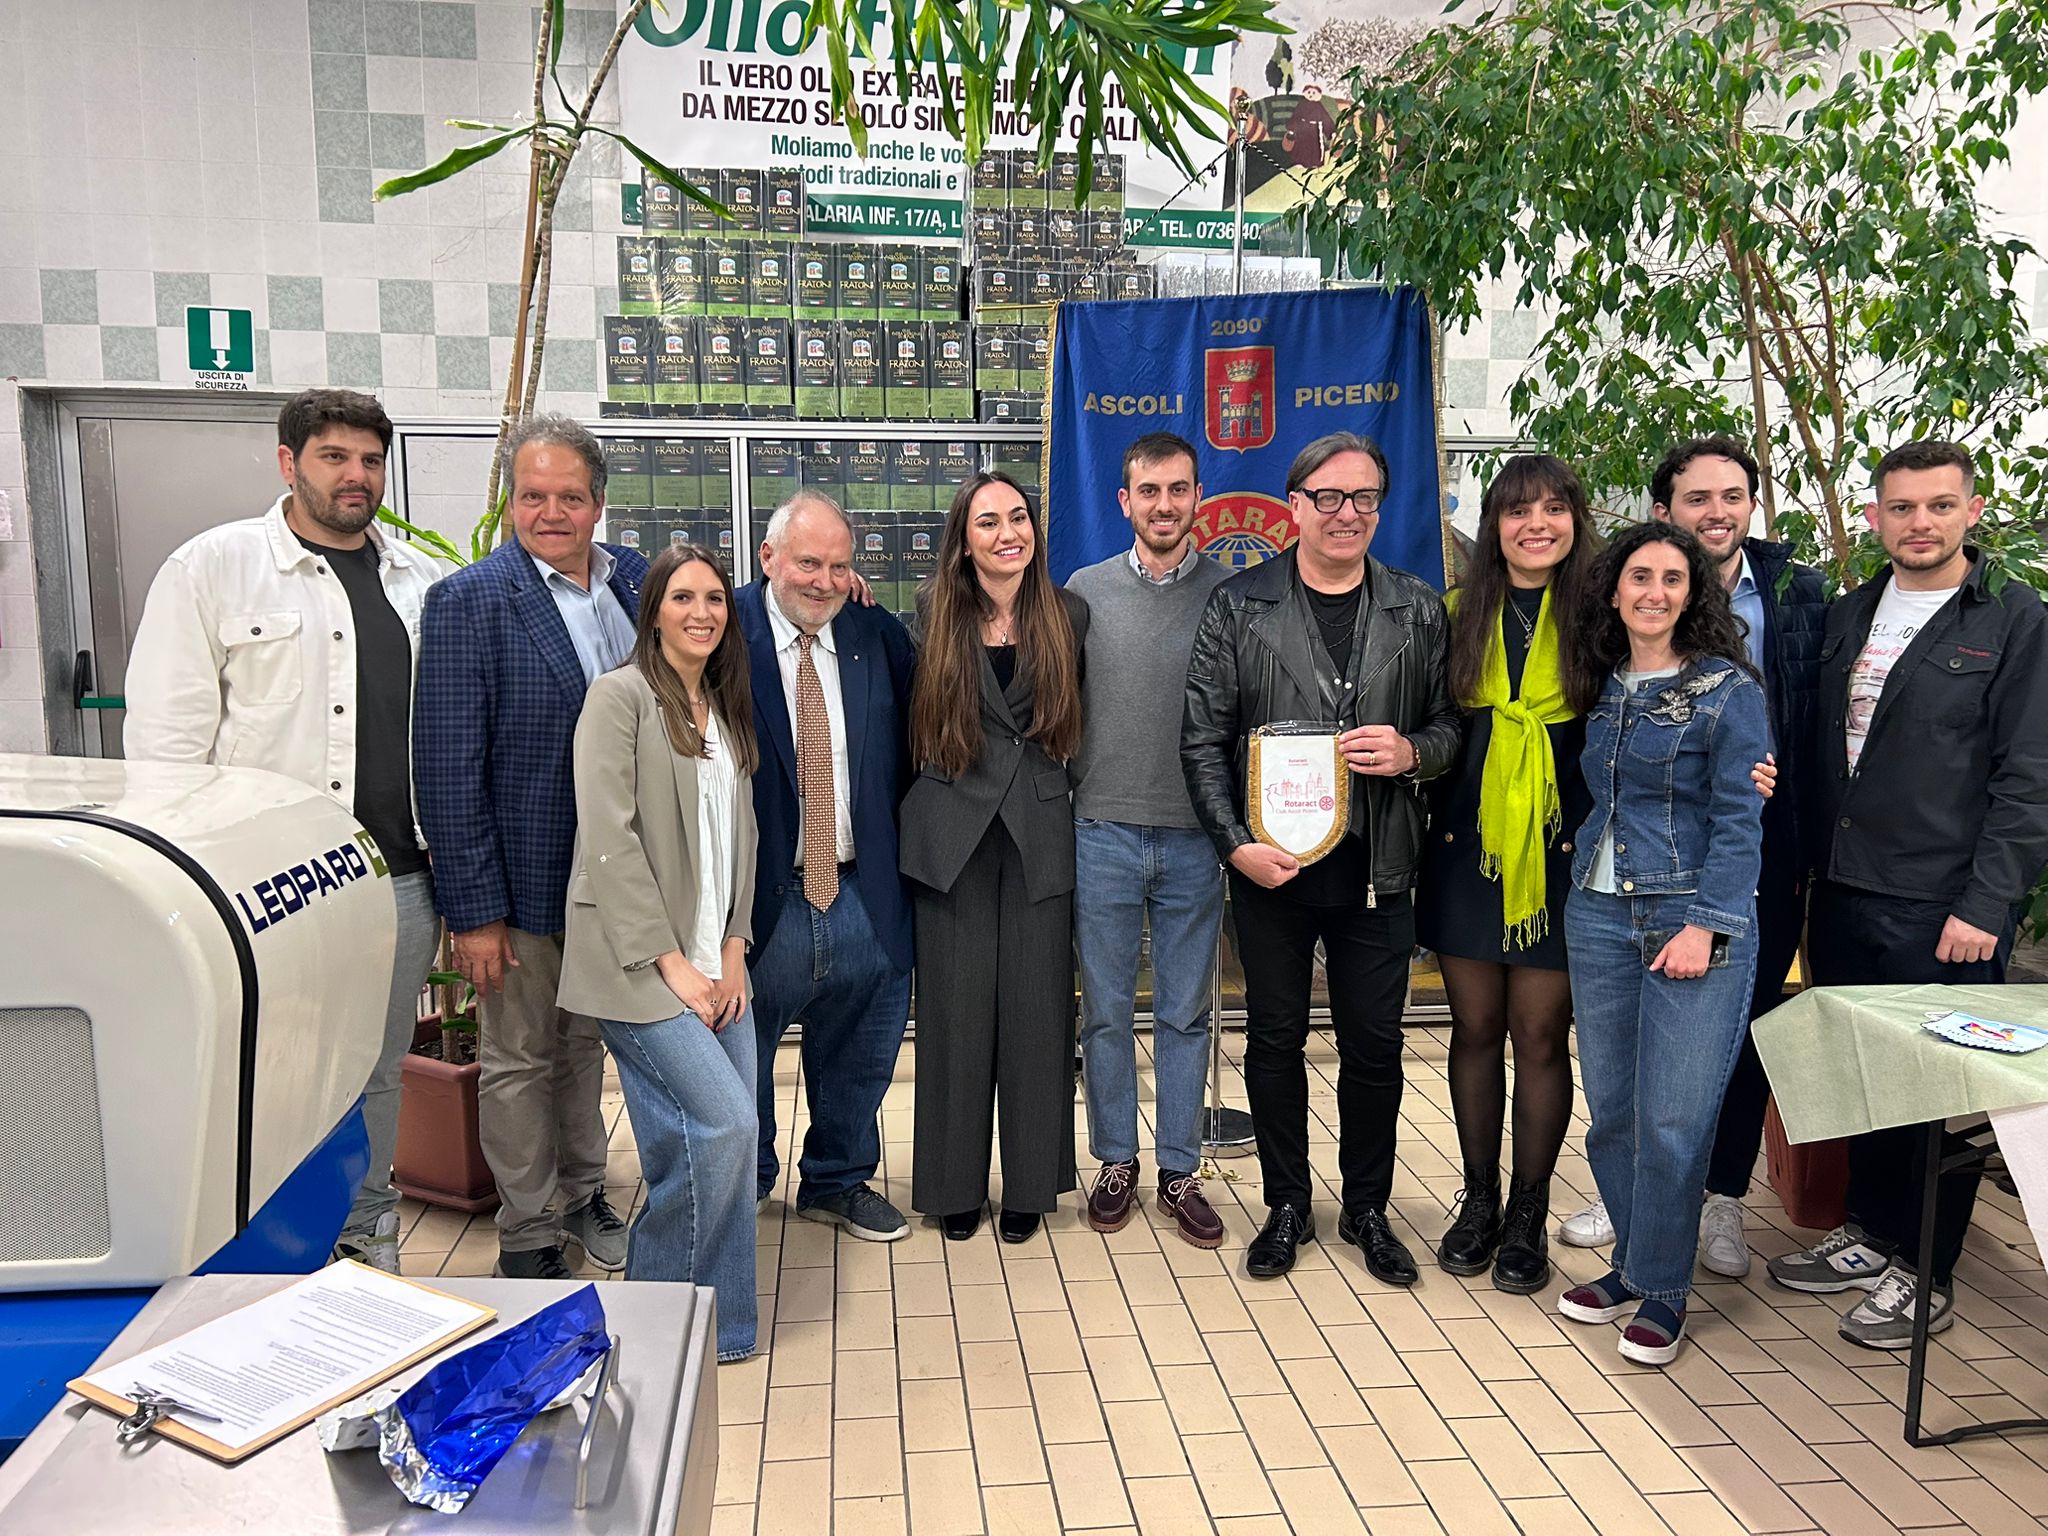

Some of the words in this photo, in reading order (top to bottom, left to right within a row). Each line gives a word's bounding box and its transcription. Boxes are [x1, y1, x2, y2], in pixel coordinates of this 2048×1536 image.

[700, 59, 721, 87] IL
[727, 63, 793, 91] VERO
[682, 92, 717, 120] DA
[724, 95, 807, 125] MEZZO
[771, 134, 852, 159] Moliamo
[865, 140, 914, 161] nche
[920, 142, 935, 162] le
[839, 166, 941, 190] tradizionali
[946, 174, 957, 190] e
[806, 205, 864, 224] ALARIA
[869, 206, 899, 226] INF.
[904, 208, 946, 231] 17/A,
[1159, 219, 1192, 239] TEL.
[194, 381, 248, 391] SICUREZZA
[198, 371, 232, 380] USCITA
[234, 372, 244, 381] DI
[1084, 392, 1184, 416] ASCOLI
[1294, 382, 1400, 408] PICENO
[1284, 800, 1317, 808] Rotaract
[235, 842, 368, 935] LEOPARD
